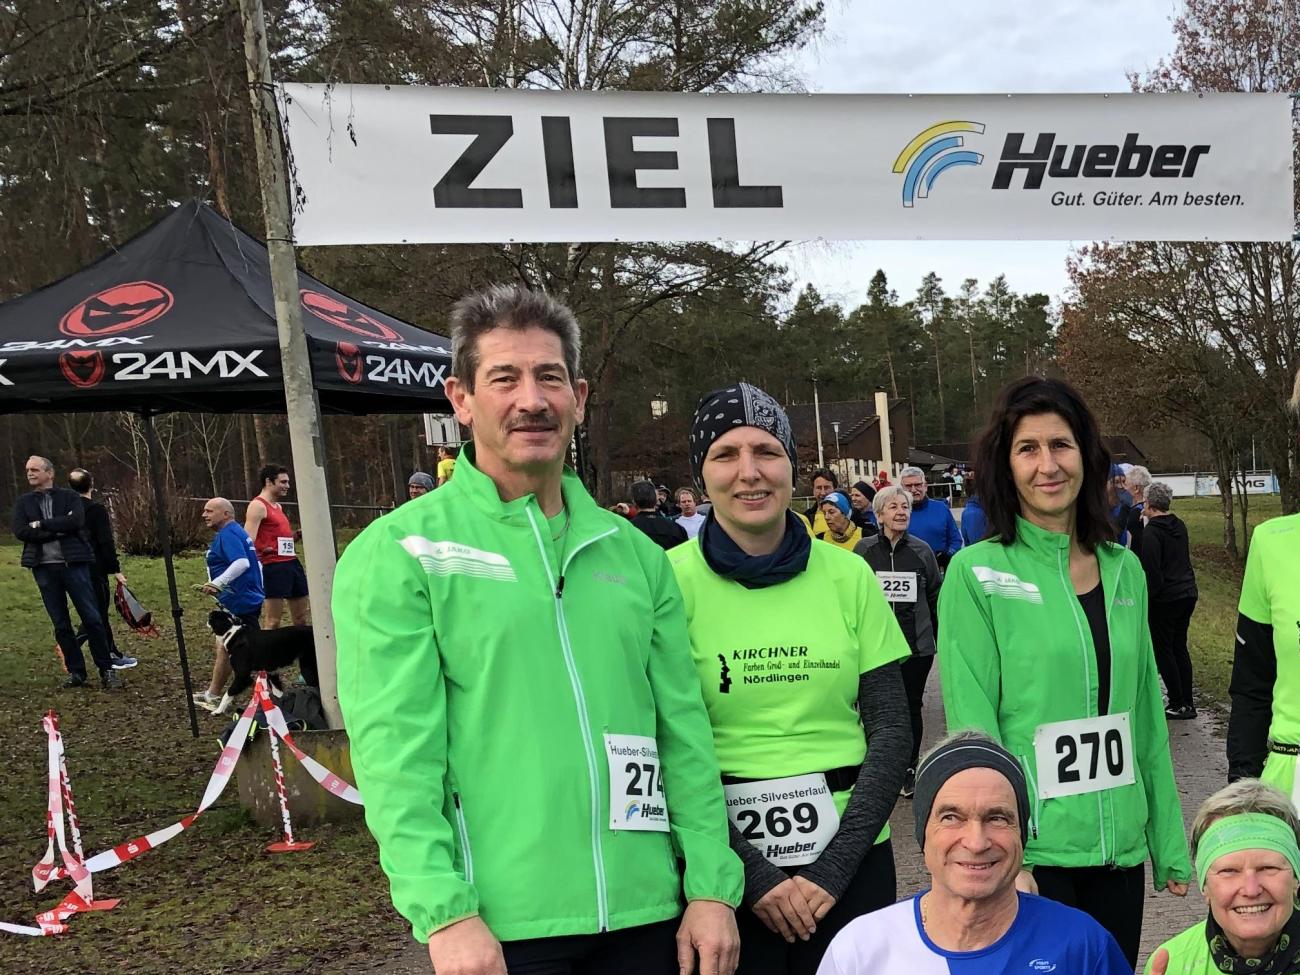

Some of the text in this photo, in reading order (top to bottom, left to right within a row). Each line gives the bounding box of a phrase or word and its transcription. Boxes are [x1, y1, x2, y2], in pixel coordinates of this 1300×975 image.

[430, 114, 784, 208] ZIEL
[991, 132, 1211, 190] Hueber
[1050, 190, 1245, 206] Gut. Güter. Am besten.
[112, 350, 268, 380] 24MX
[367, 355, 447, 387] 24MX
[883, 580, 910, 592] 225
[733, 646, 809, 660] KIRCHNER
[788, 661, 801, 670] und
[743, 673, 810, 685] Nördlingen
[1055, 729, 1124, 783] 270
[725, 786, 828, 807] ueber-Silvesterlauf
[641, 803, 665, 818] Hueber
[736, 802, 819, 840] 269
[766, 841, 817, 858] Hueber
